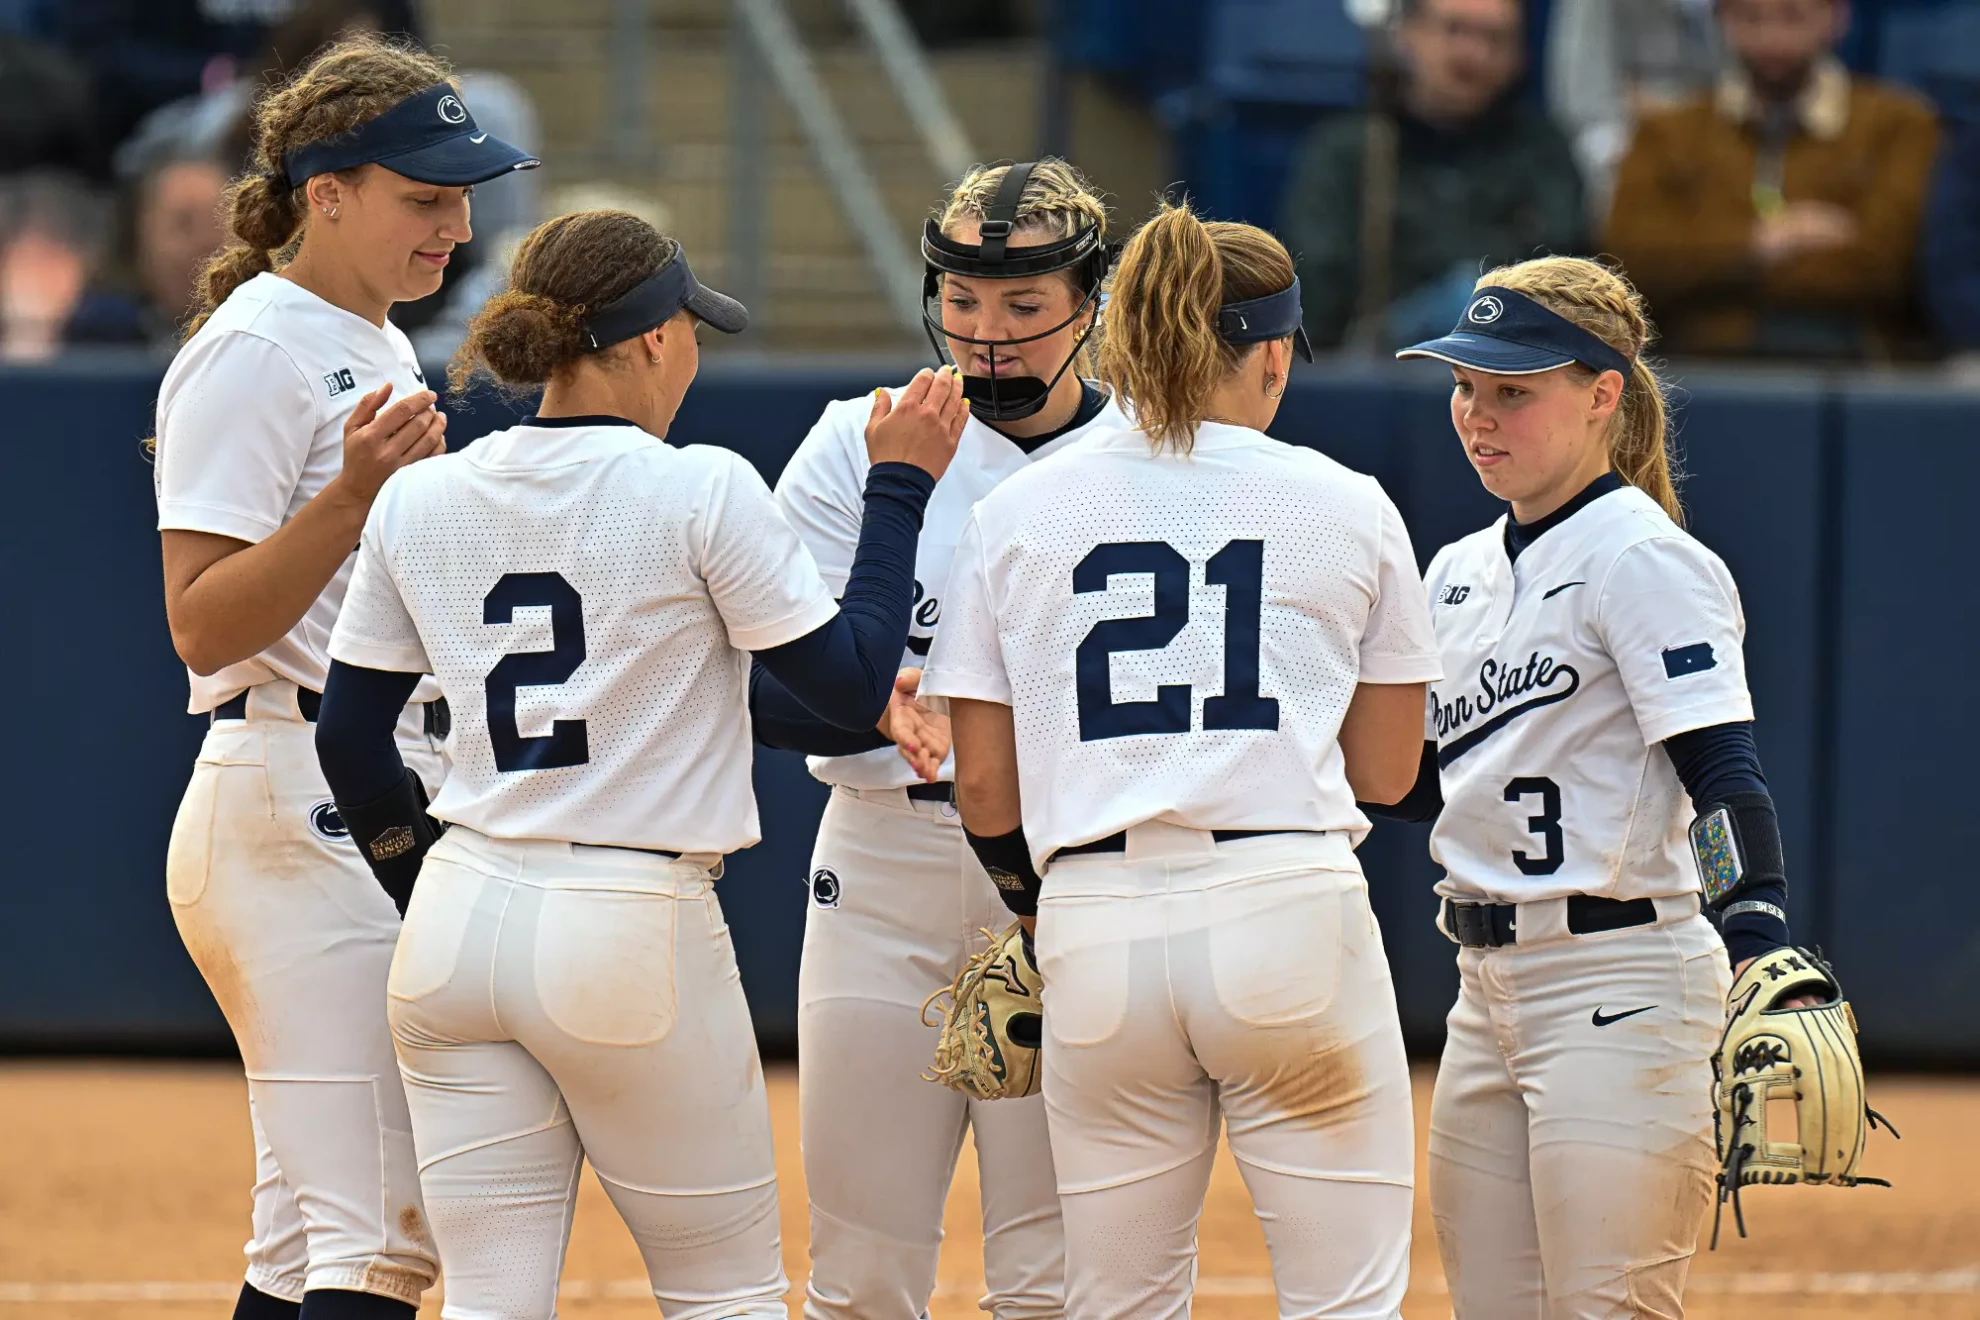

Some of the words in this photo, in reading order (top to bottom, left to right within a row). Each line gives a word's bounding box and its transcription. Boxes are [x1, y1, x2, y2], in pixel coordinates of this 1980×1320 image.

[482, 571, 590, 773] 2
[1072, 538, 1280, 742] 21
[1476, 651, 1556, 715] State
[1503, 776, 1565, 876] 3
